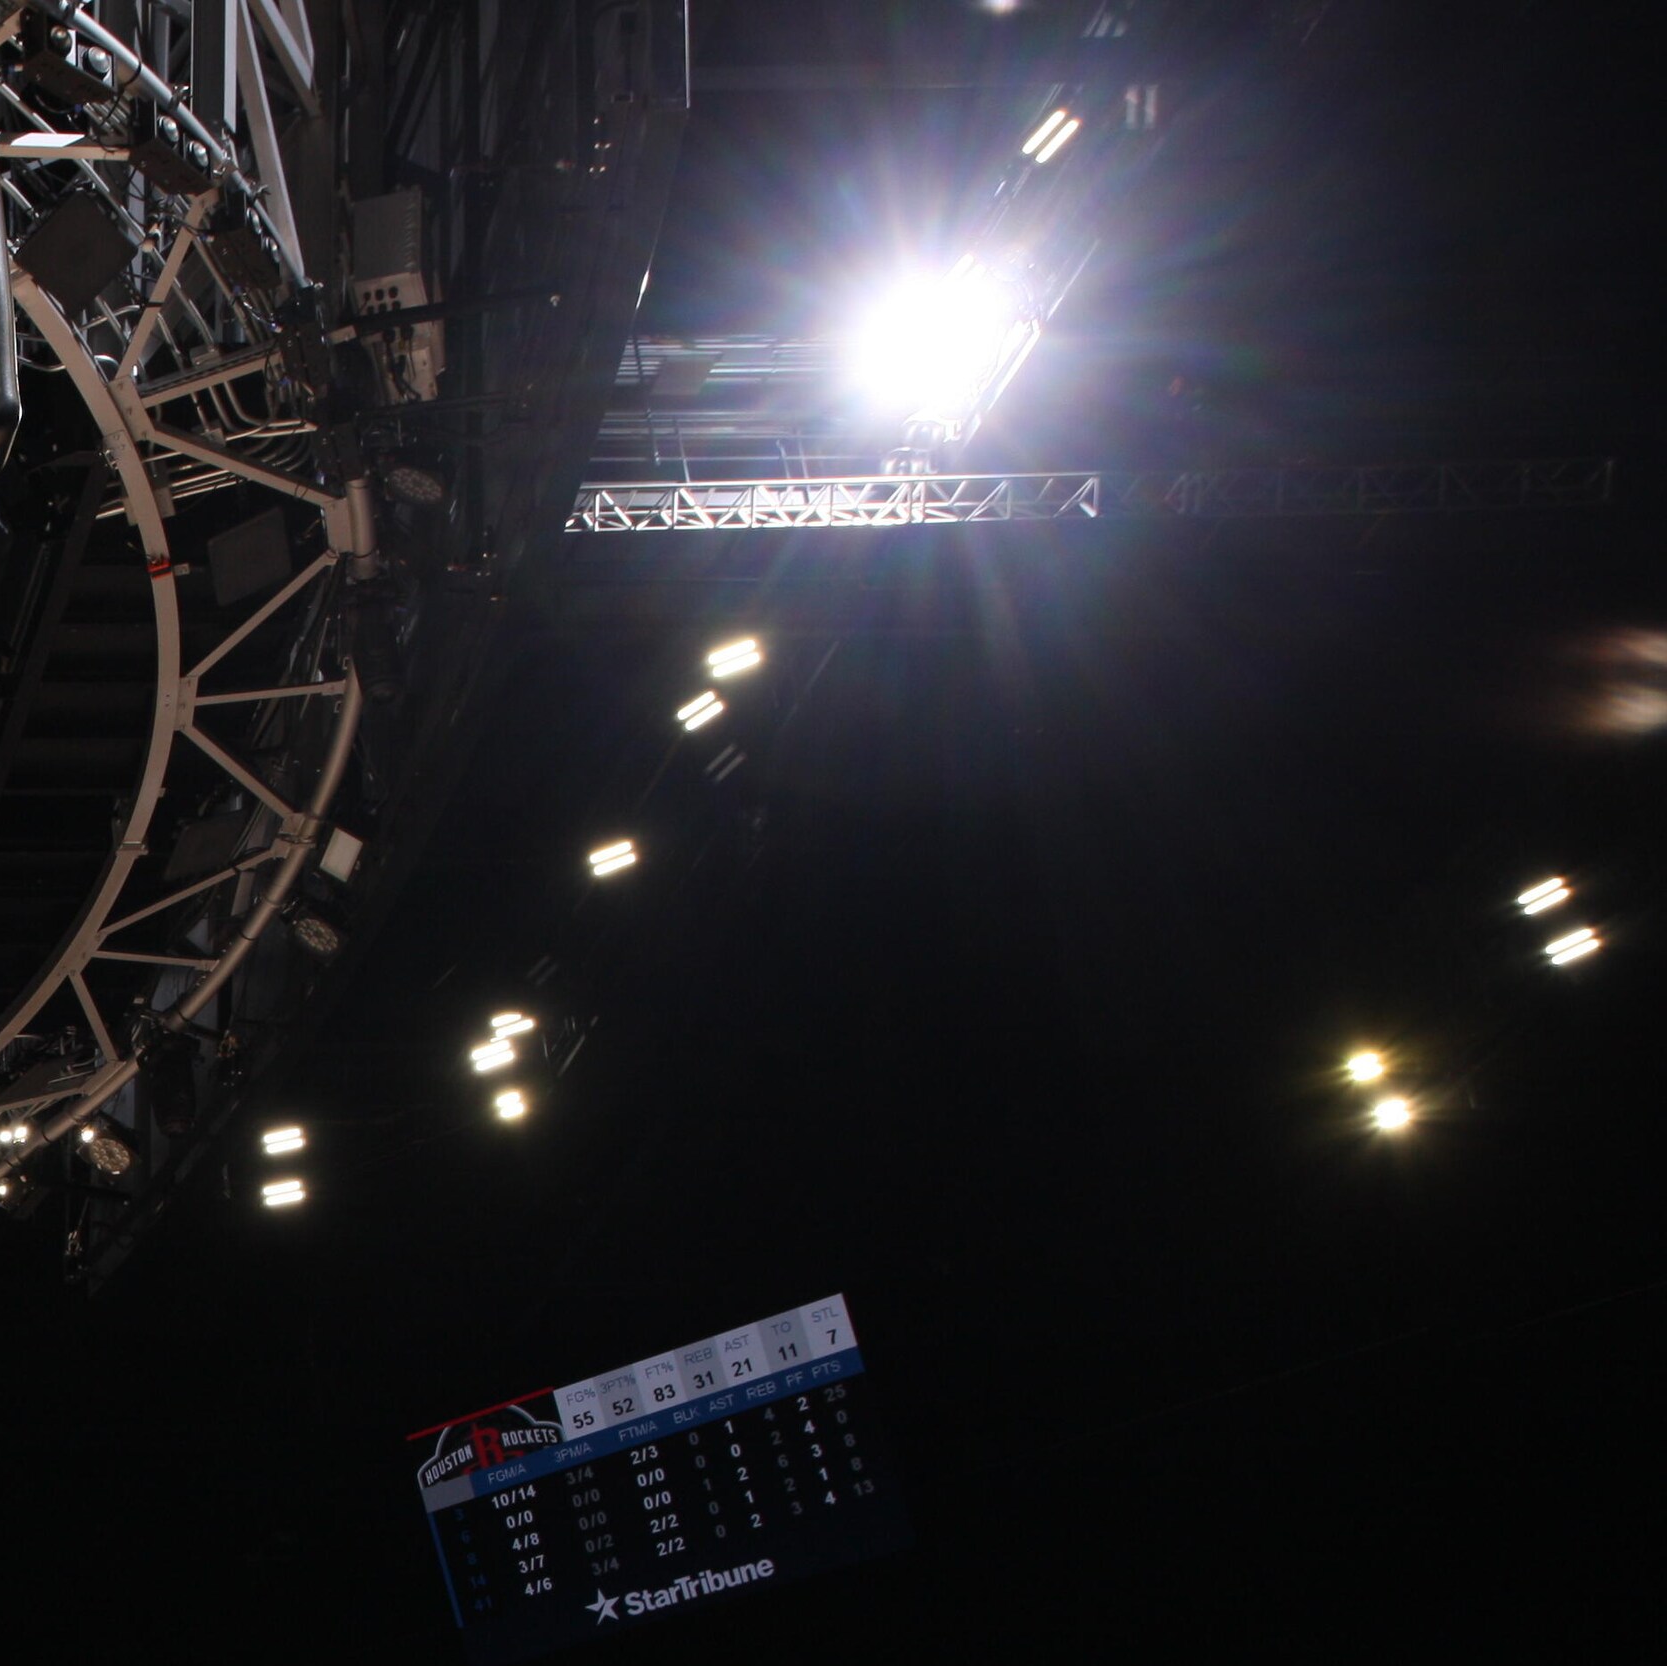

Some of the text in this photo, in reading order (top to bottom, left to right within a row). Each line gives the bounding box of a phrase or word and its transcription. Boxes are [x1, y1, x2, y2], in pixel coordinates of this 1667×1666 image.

[573, 1329, 837, 1430] 55 52 83 31 21 11 7
[425, 1428, 558, 1486] HOUSTON ROCKETS
[492, 1445, 659, 1509] 10/14 2/3
[624, 1558, 775, 1615] StarTribune
